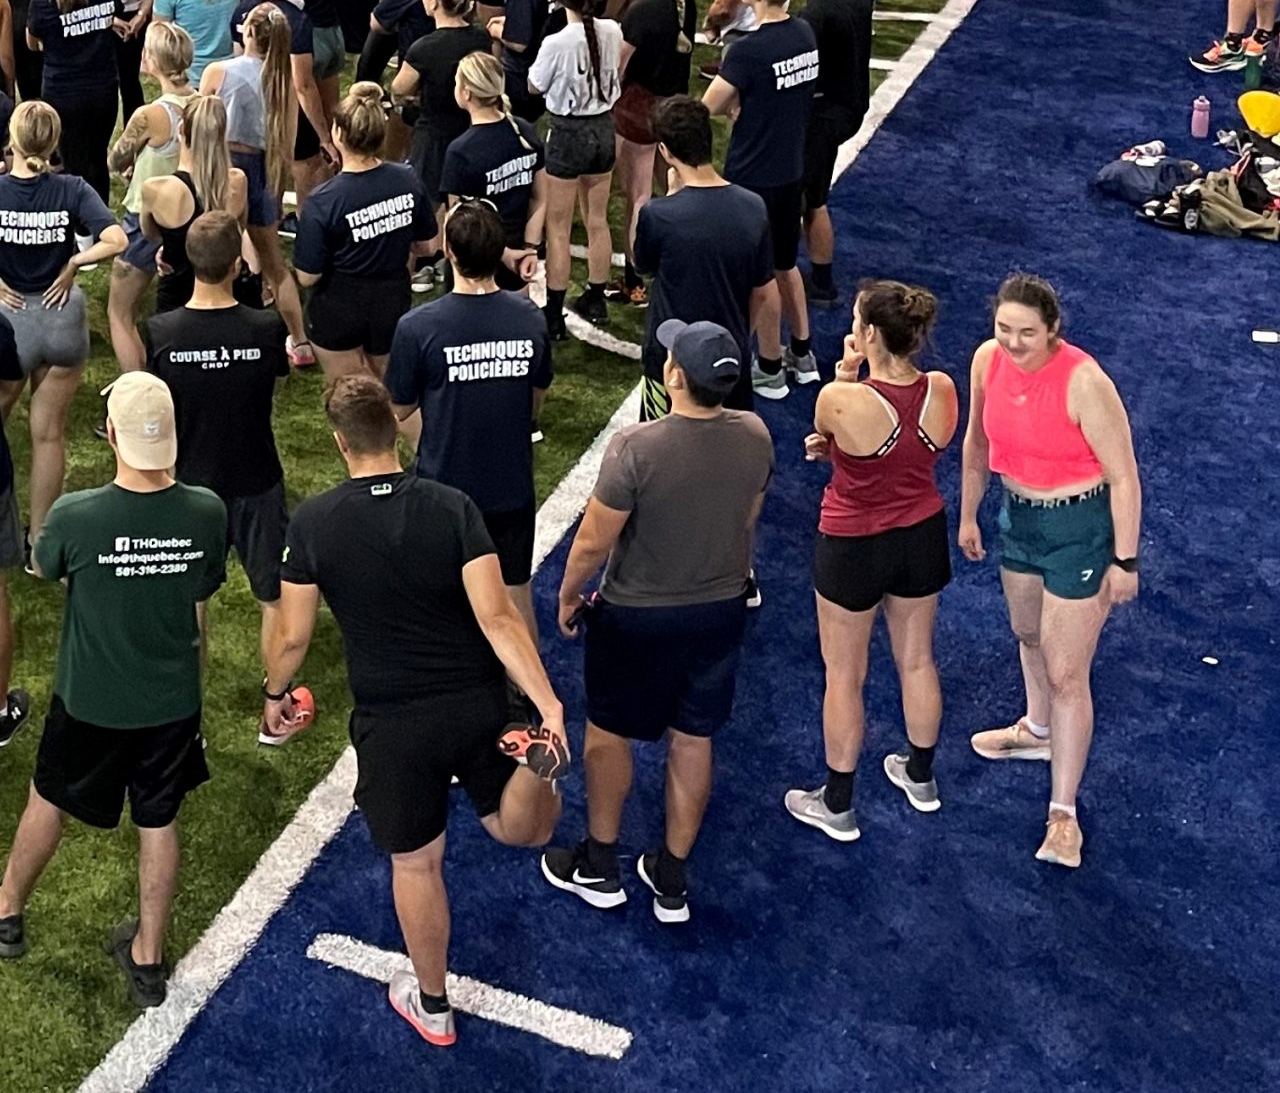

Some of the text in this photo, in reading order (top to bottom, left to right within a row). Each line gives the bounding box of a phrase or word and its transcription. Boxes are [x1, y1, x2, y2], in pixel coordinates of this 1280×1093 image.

[345, 193, 415, 228] TECHNIQUES
[169, 349, 218, 363] COURSE
[232, 348, 261, 361] PIED
[443, 339, 534, 365] TECHNIQUES
[448, 358, 530, 382] POLICIÈRES
